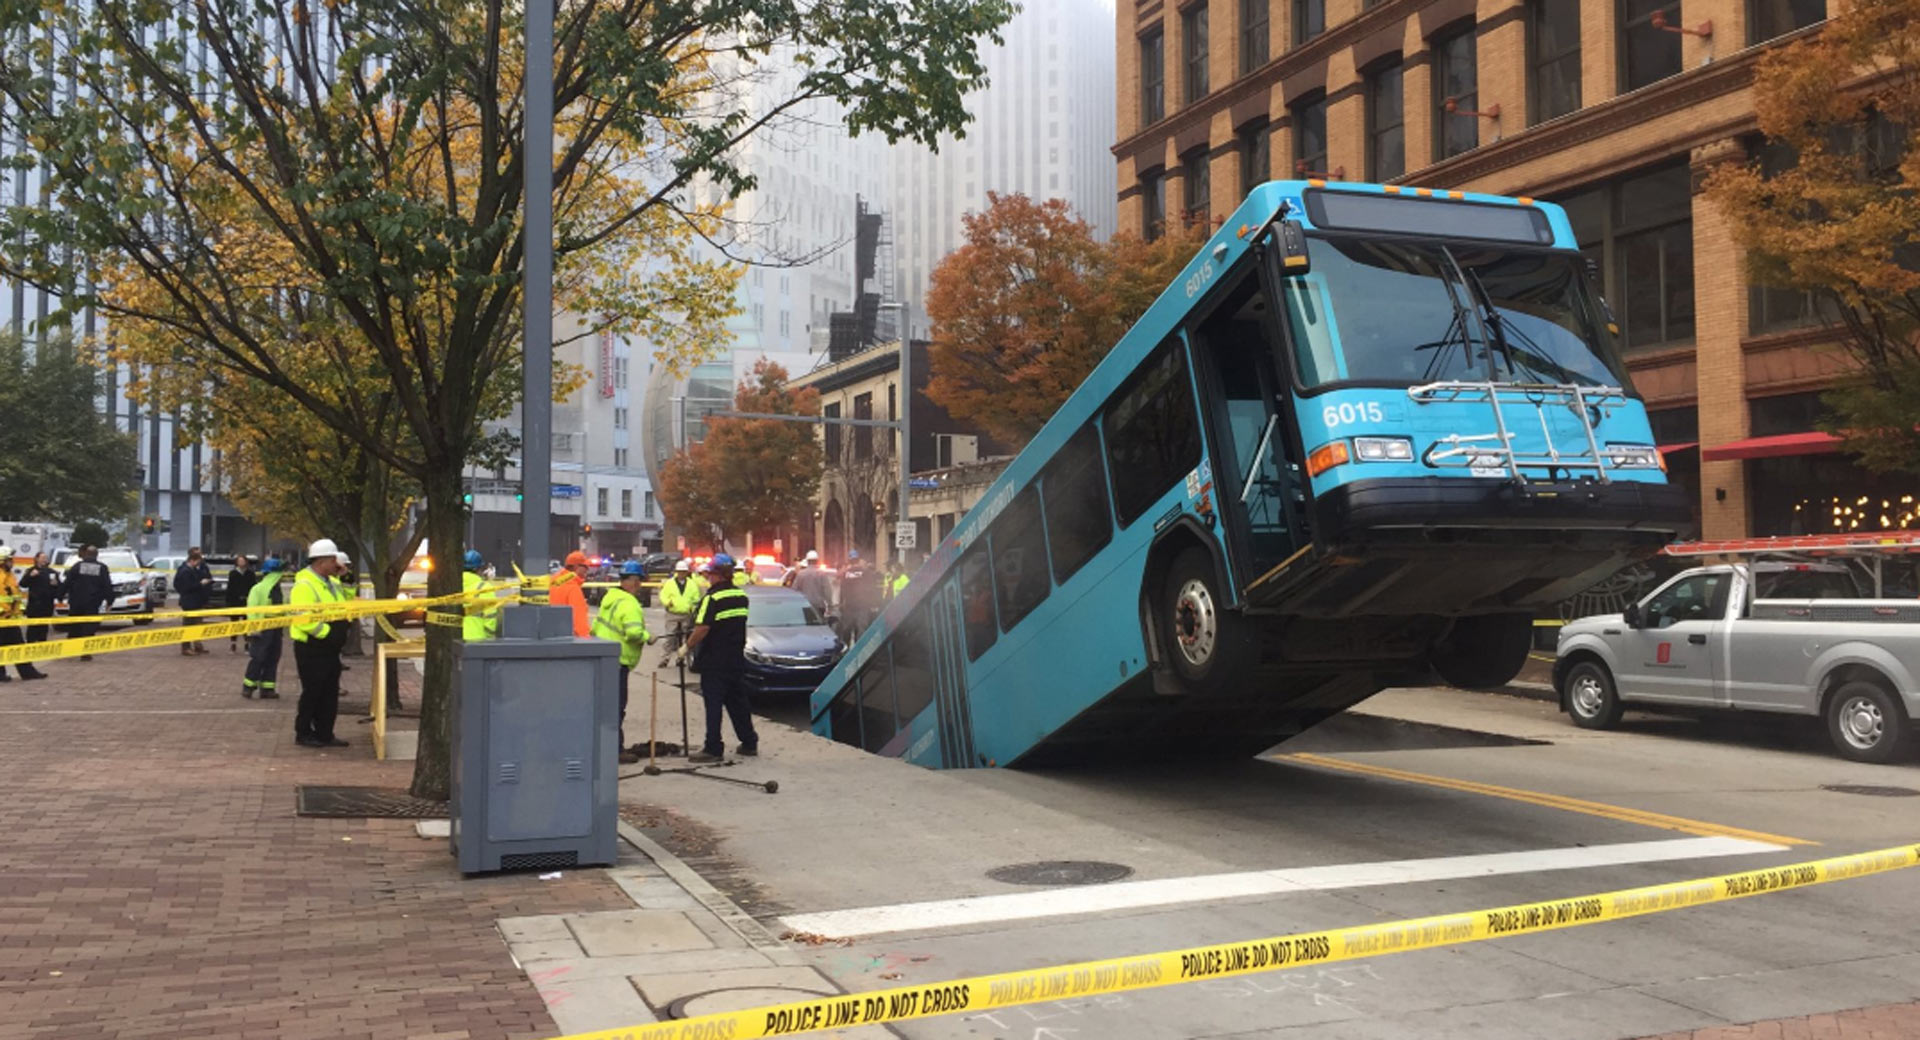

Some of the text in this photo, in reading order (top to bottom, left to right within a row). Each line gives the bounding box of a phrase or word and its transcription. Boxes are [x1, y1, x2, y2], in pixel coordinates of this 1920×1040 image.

[1186, 259, 1213, 298] 6015
[1323, 401, 1383, 428] 6015
[898, 535, 914, 546] 25
[1488, 899, 1602, 933] POLICE LINE DO NOT CROSS
[1181, 936, 1330, 977] POLICE LINE DO NOT CROSS
[988, 960, 1162, 1005] POLICE LINE DO NOT CROSS
[763, 1006, 821, 1035] POLICE
[824, 1000, 860, 1027] LINE
[862, 996, 885, 1022] DO
[887, 991, 919, 1018] NOT
[922, 984, 969, 1014] CROSS
